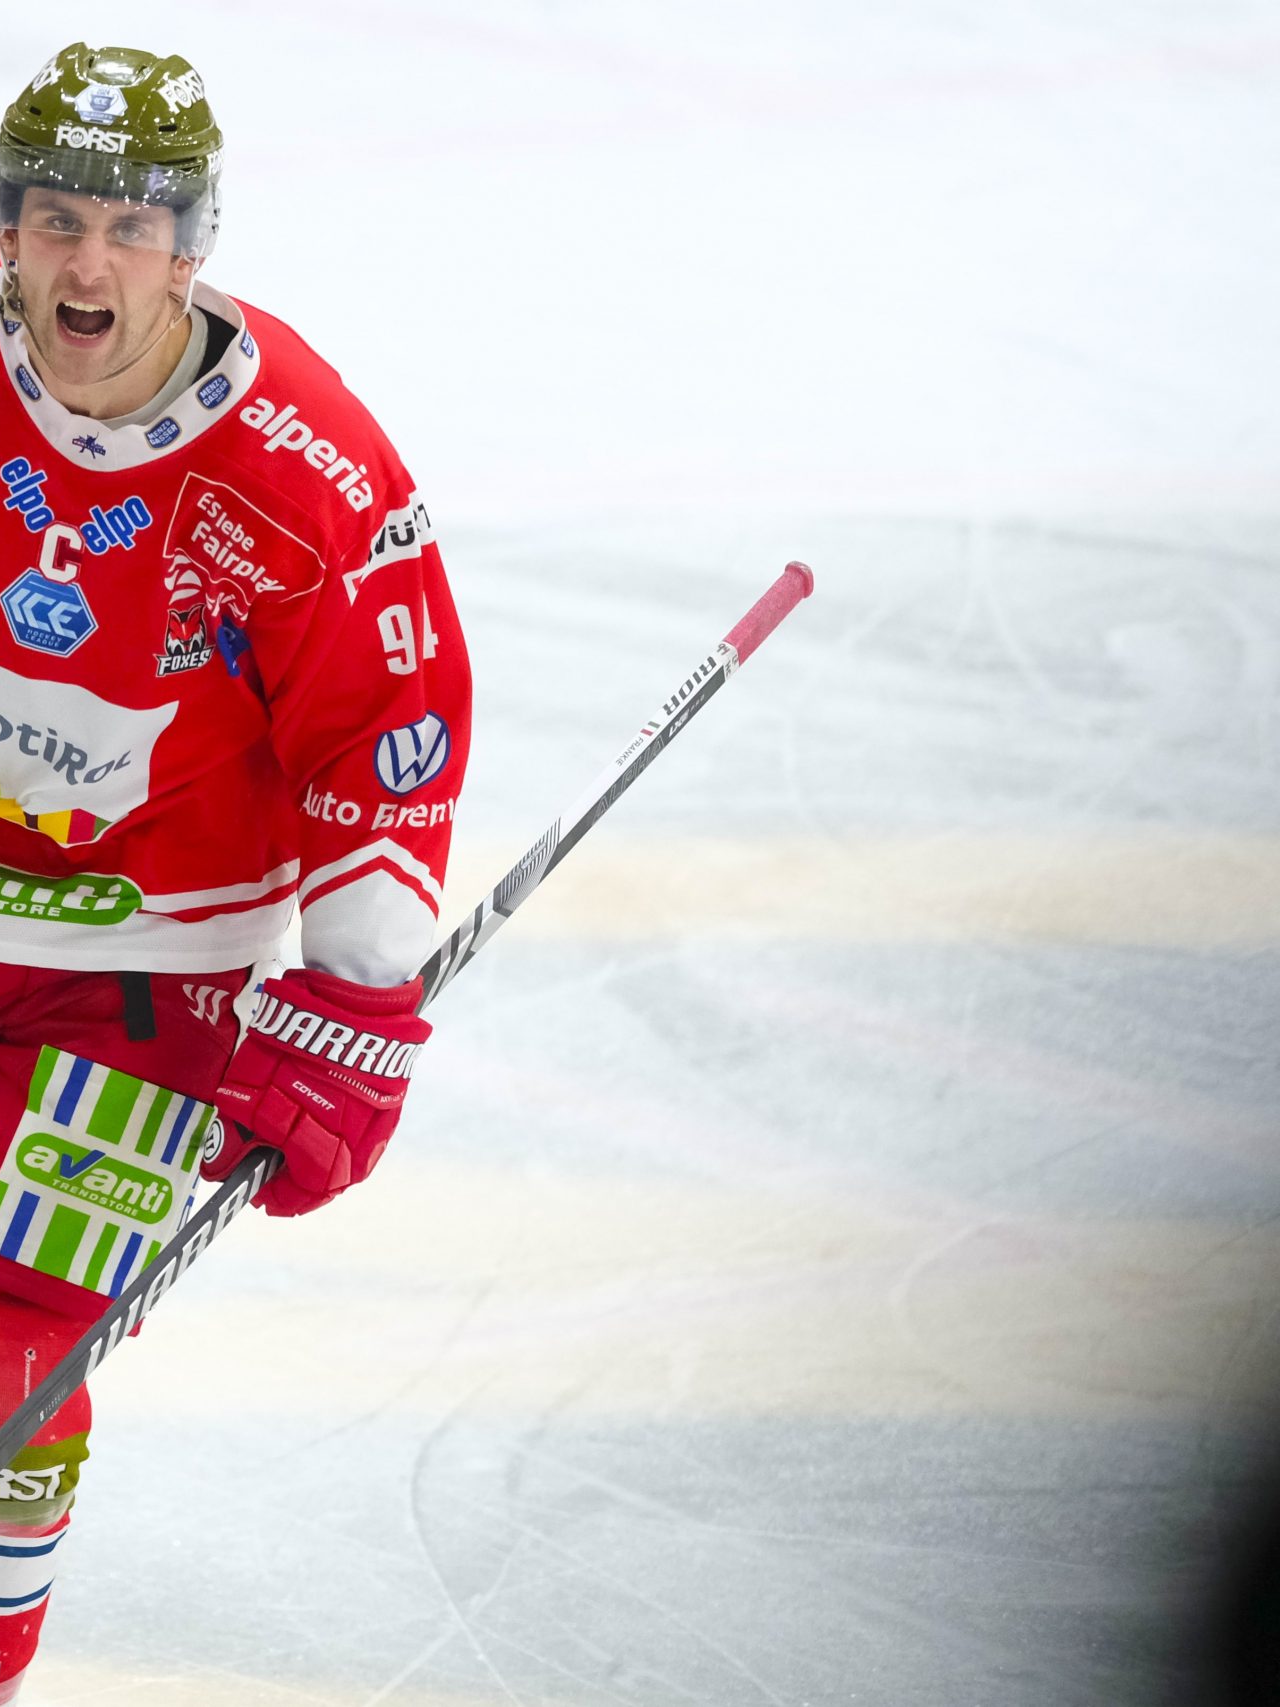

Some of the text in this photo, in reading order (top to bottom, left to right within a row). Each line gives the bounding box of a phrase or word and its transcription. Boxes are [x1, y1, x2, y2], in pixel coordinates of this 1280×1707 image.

[55, 124, 133, 155] FORST
[239, 397, 374, 513] alperia
[1, 458, 54, 532] elpo
[79, 496, 152, 554] elpo
[39, 523, 83, 584] C
[9, 588, 83, 640] ICE
[27, 629, 63, 643] HOCKEY
[158, 648, 213, 676] FOXES
[250, 993, 424, 1080] WARRIO
[291, 1080, 336, 1112] COVERT
[23, 1145, 170, 1214] avanti
[52, 1179, 138, 1217] TRENDSTORE
